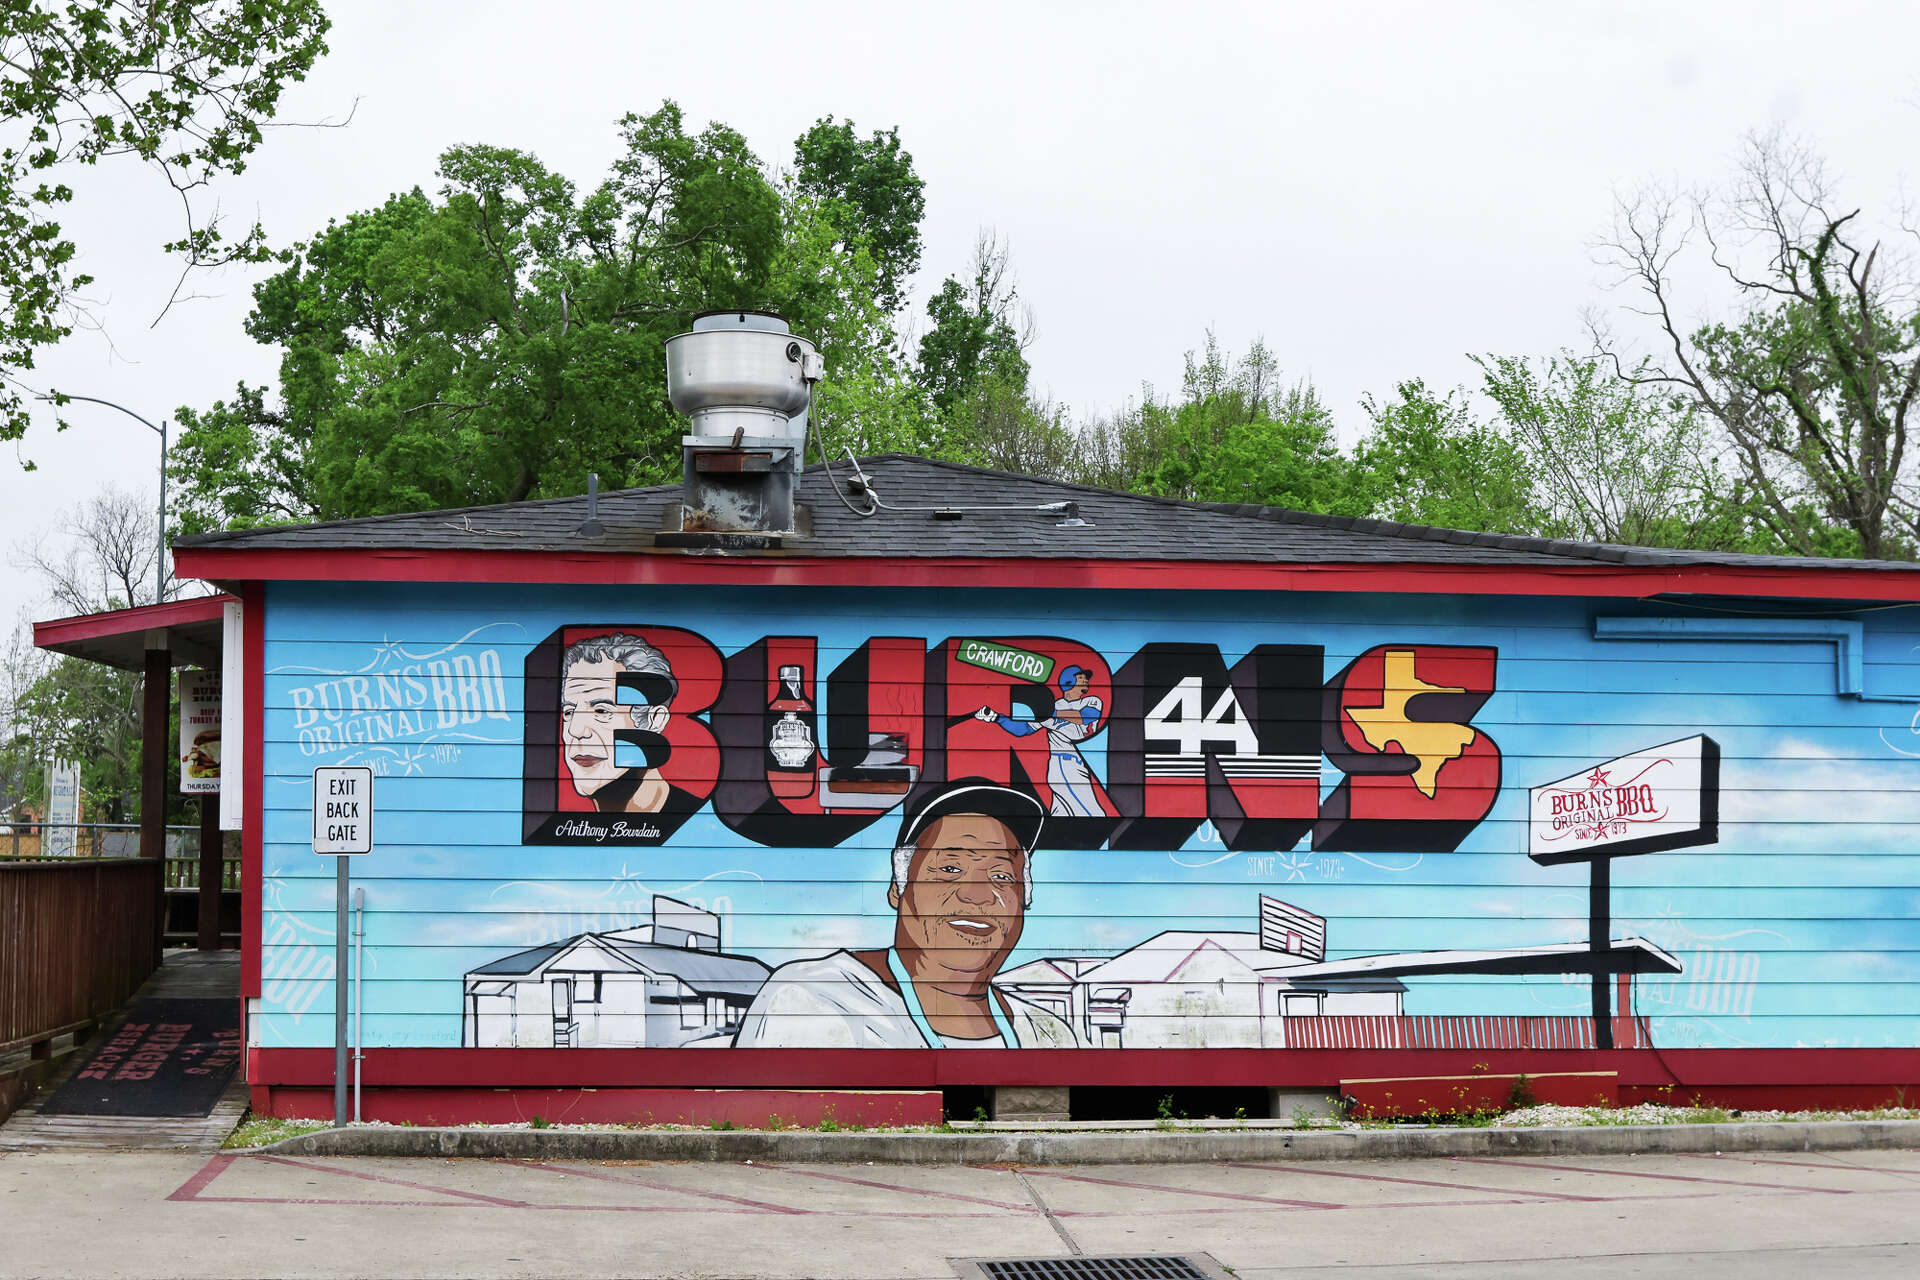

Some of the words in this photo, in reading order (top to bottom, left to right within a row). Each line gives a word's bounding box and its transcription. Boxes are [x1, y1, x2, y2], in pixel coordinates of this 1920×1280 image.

[966, 643, 1044, 677] CRAWFORD
[288, 664, 428, 729] BURNS
[428, 649, 512, 730] BBQ
[298, 707, 433, 757] ORIGINAL
[1144, 676, 1259, 756] 44
[524, 624, 1504, 852] BURNS
[329, 779, 357, 796] EXIT
[1551, 788, 1613, 815] BURNS
[1615, 784, 1658, 817] BBQ
[326, 802, 359, 818] BACK
[1552, 807, 1614, 831] ORIGINAL
[328, 825, 357, 841] GATE
[555, 820, 609, 842] Anthony
[610, 821, 661, 838] Bourdain
